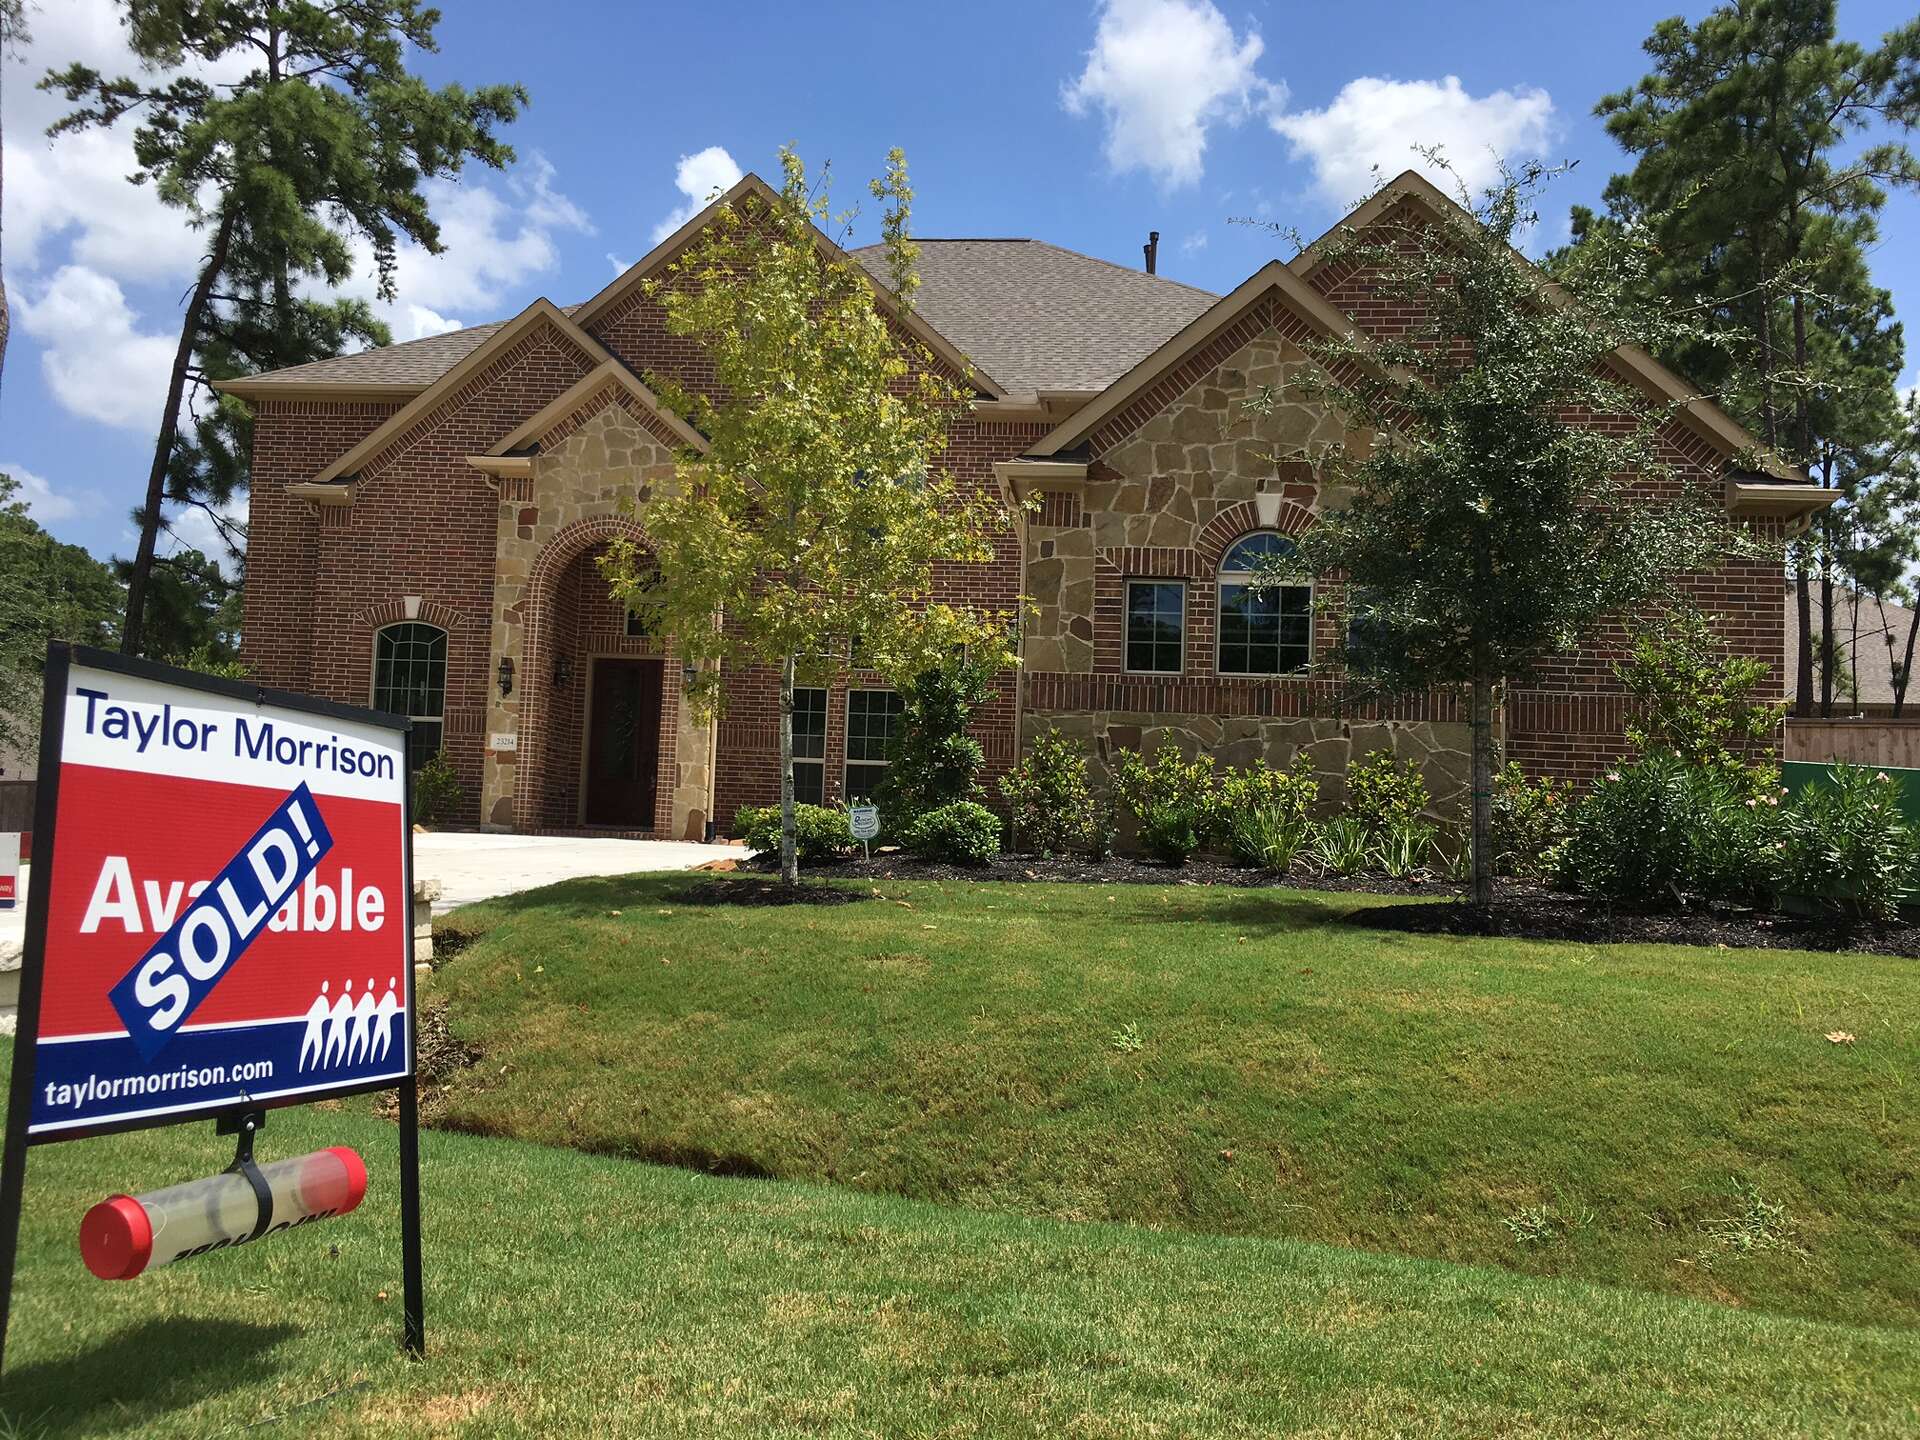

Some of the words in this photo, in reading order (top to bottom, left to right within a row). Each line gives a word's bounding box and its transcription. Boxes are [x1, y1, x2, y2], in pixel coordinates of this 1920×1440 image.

[76, 687, 217, 753] Taylor
[234, 718, 394, 780] Morrison
[79, 855, 385, 934] Avable
[134, 799, 320, 1031] SOLD!
[44, 1060, 273, 1109] taylormorrison.com
